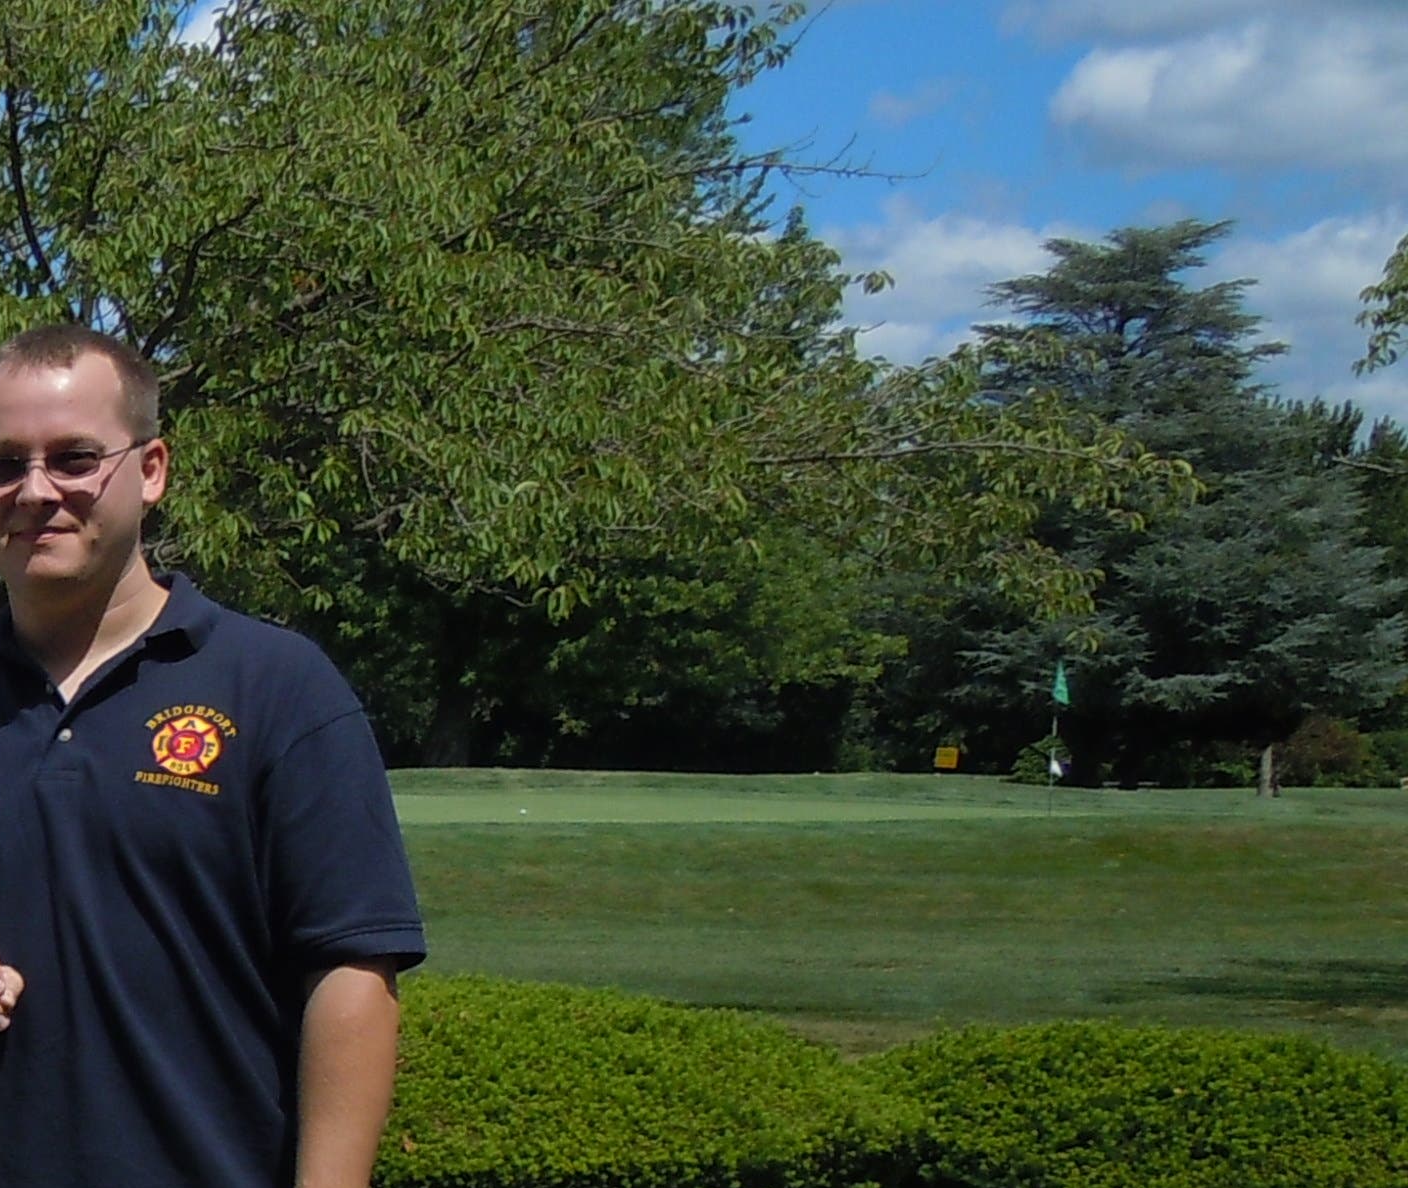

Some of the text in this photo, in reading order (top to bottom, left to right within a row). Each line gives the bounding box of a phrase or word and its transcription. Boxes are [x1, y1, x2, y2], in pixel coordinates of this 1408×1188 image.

[145, 704, 237, 737] BRIDGEPORT
[176, 737, 195, 754] F
[134, 771, 220, 795] FIREFIGHTERS
